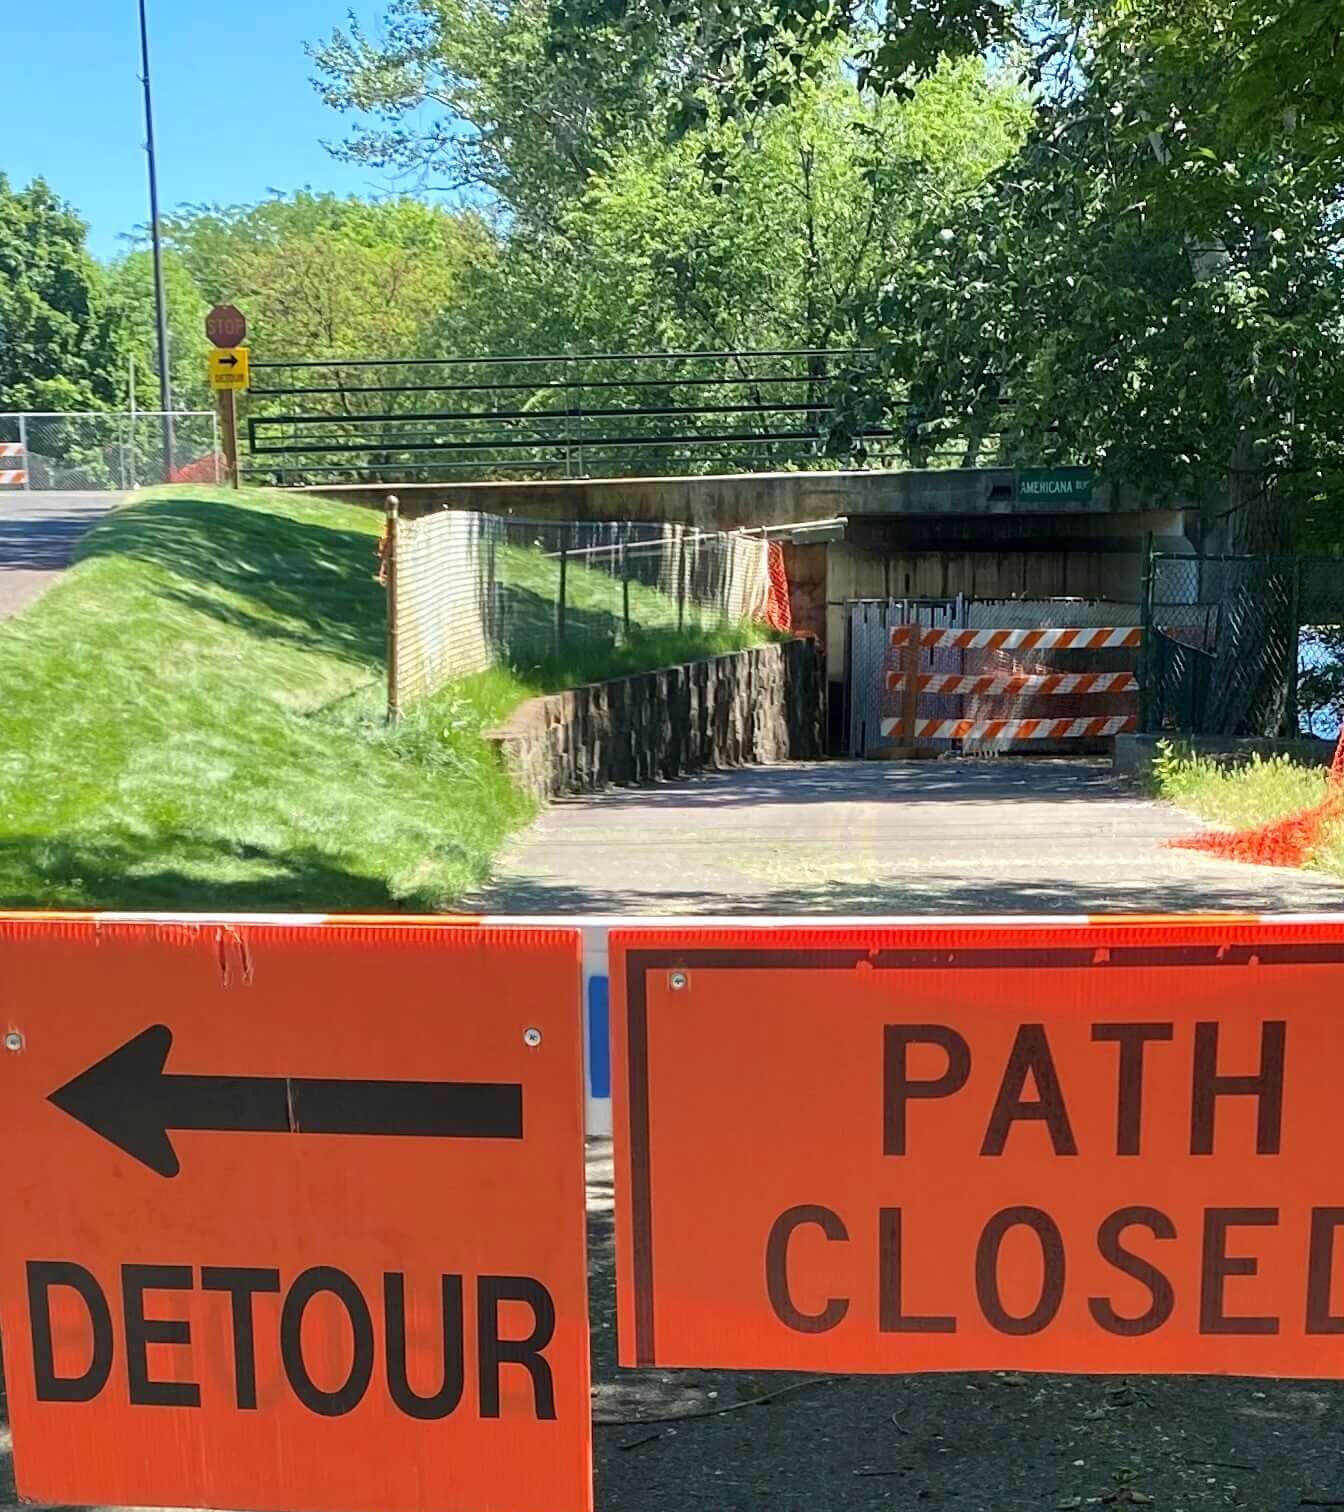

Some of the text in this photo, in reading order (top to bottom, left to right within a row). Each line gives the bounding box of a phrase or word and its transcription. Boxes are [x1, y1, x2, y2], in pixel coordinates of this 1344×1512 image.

[208, 319, 244, 336] STOP
[1021, 480, 1073, 494] AMERICANA
[882, 1020, 1288, 1157] PATH
[26, 1260, 557, 1421] DETOUR
